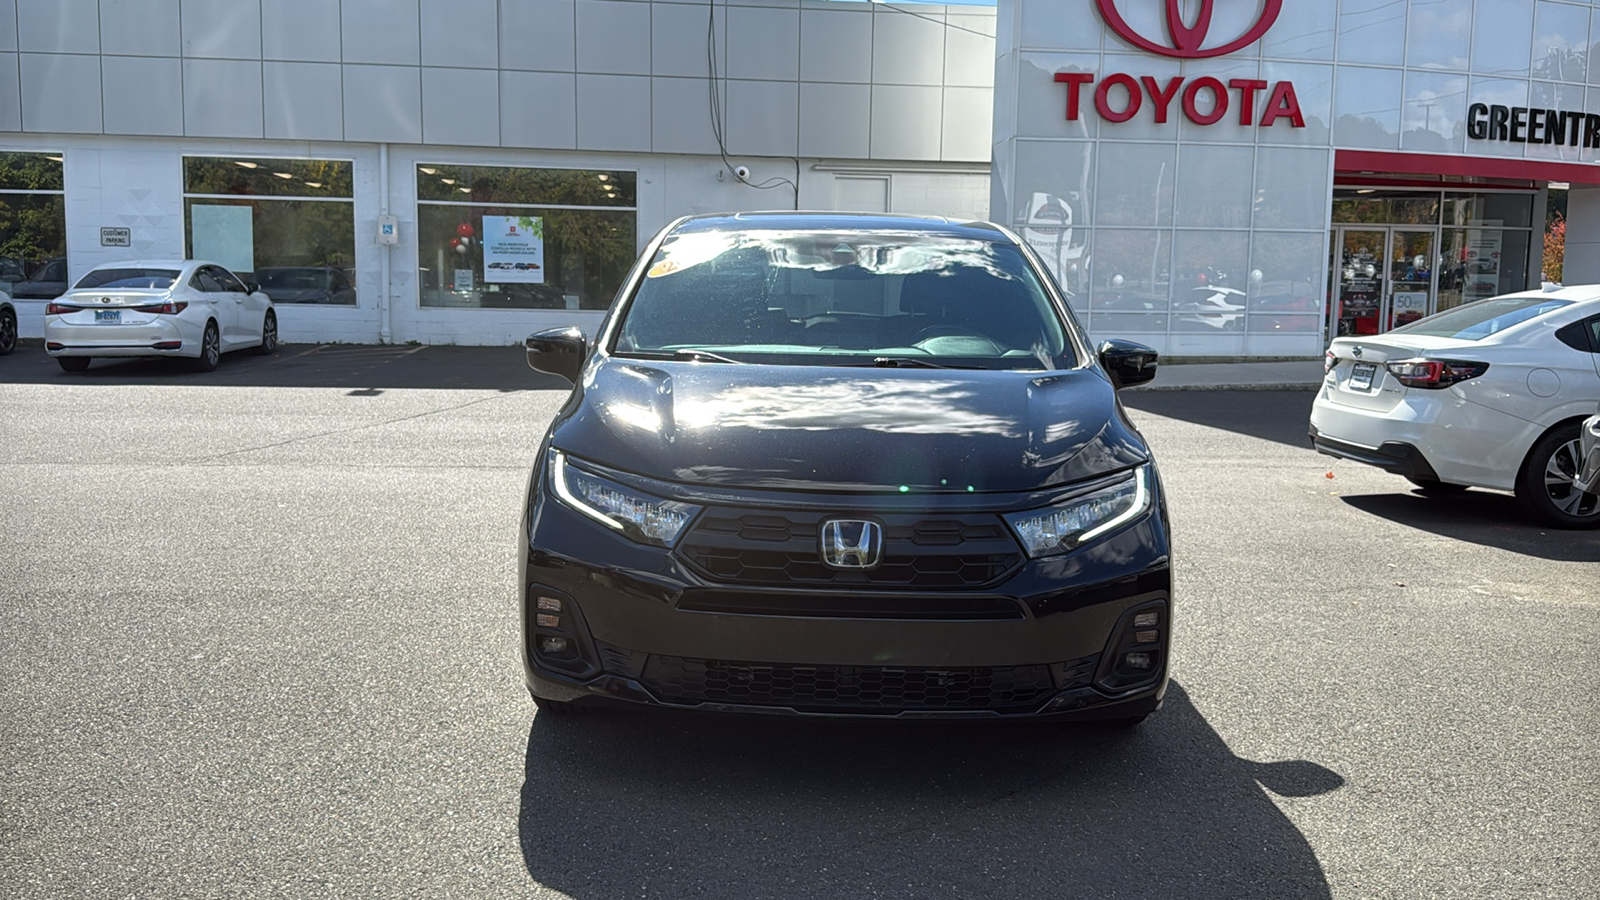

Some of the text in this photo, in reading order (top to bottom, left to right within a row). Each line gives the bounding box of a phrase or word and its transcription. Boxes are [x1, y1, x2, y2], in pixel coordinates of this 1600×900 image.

[1054, 72, 1306, 128] TOYOTA
[1467, 102, 1600, 149] GREENTR
[1397, 295, 1412, 309] 50
